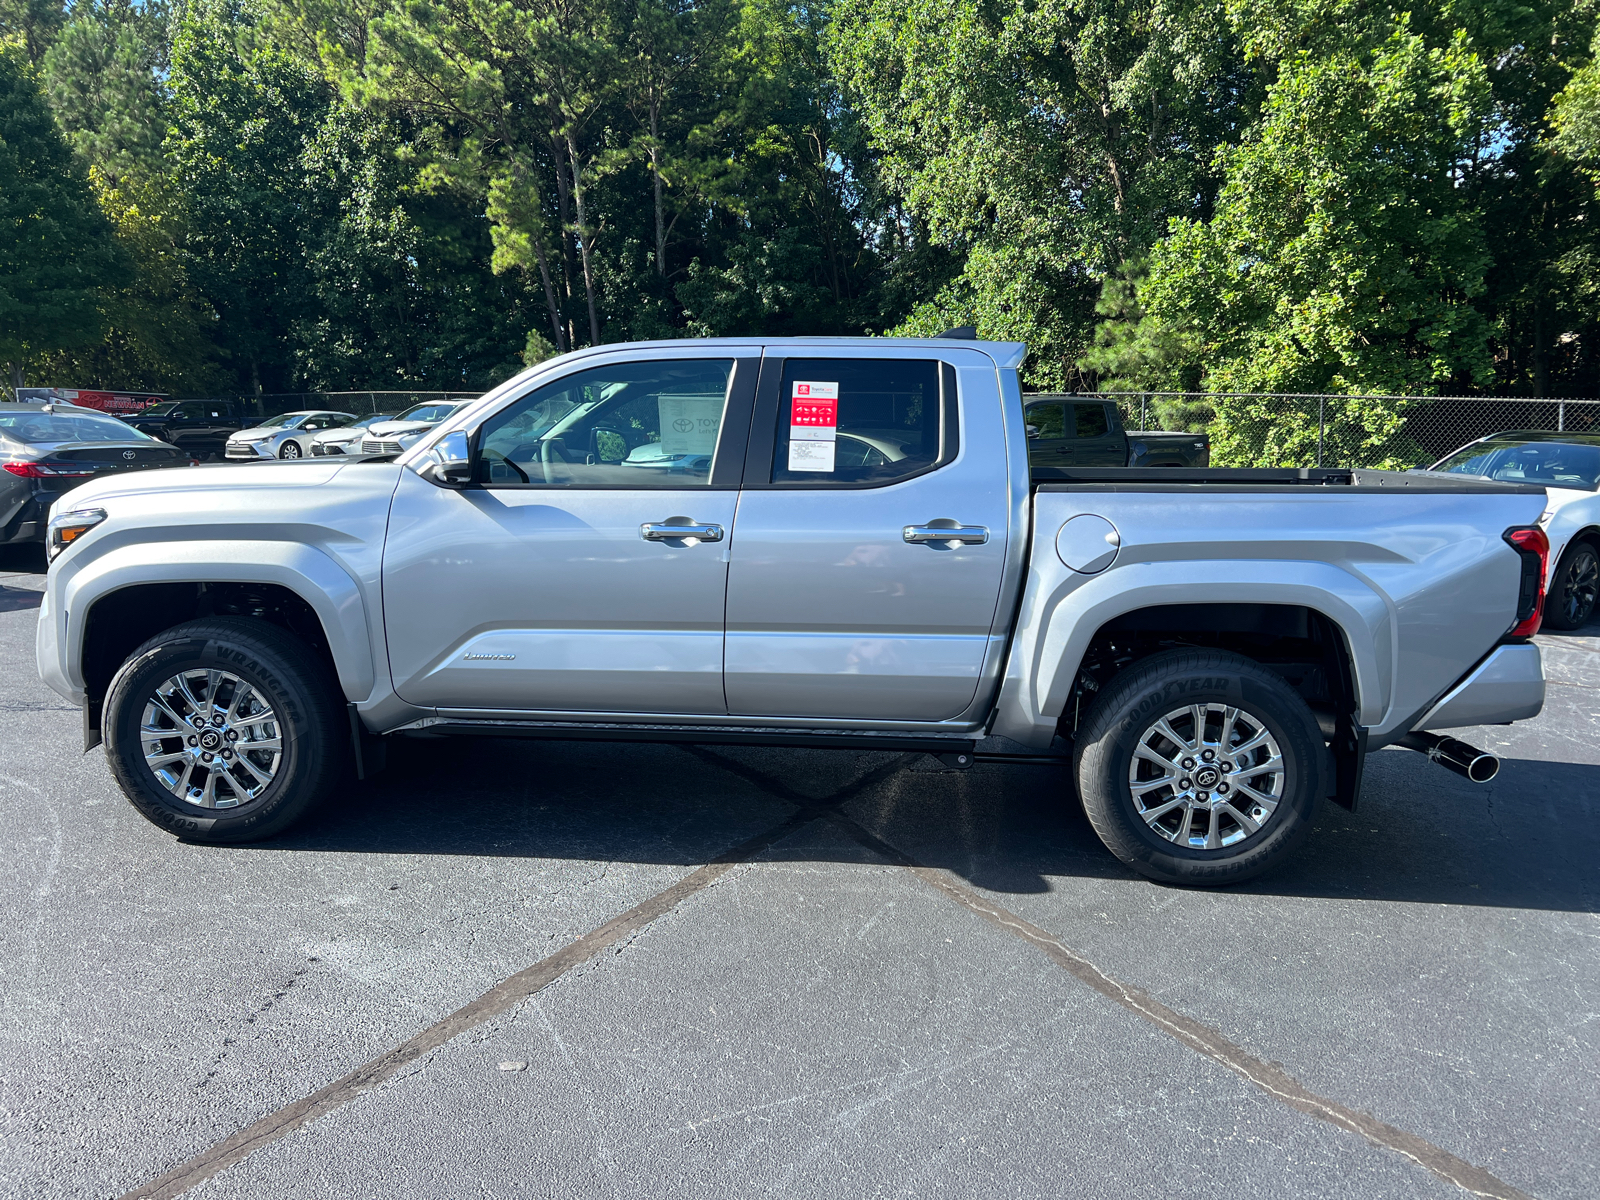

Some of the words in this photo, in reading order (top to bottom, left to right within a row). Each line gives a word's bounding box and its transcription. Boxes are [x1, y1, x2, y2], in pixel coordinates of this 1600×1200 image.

[104, 400, 145, 409] NEWNAN
[216, 646, 301, 724] WRANGLER
[1121, 677, 1230, 732] GOODYEAR
[1189, 825, 1298, 878] WRANGLER
